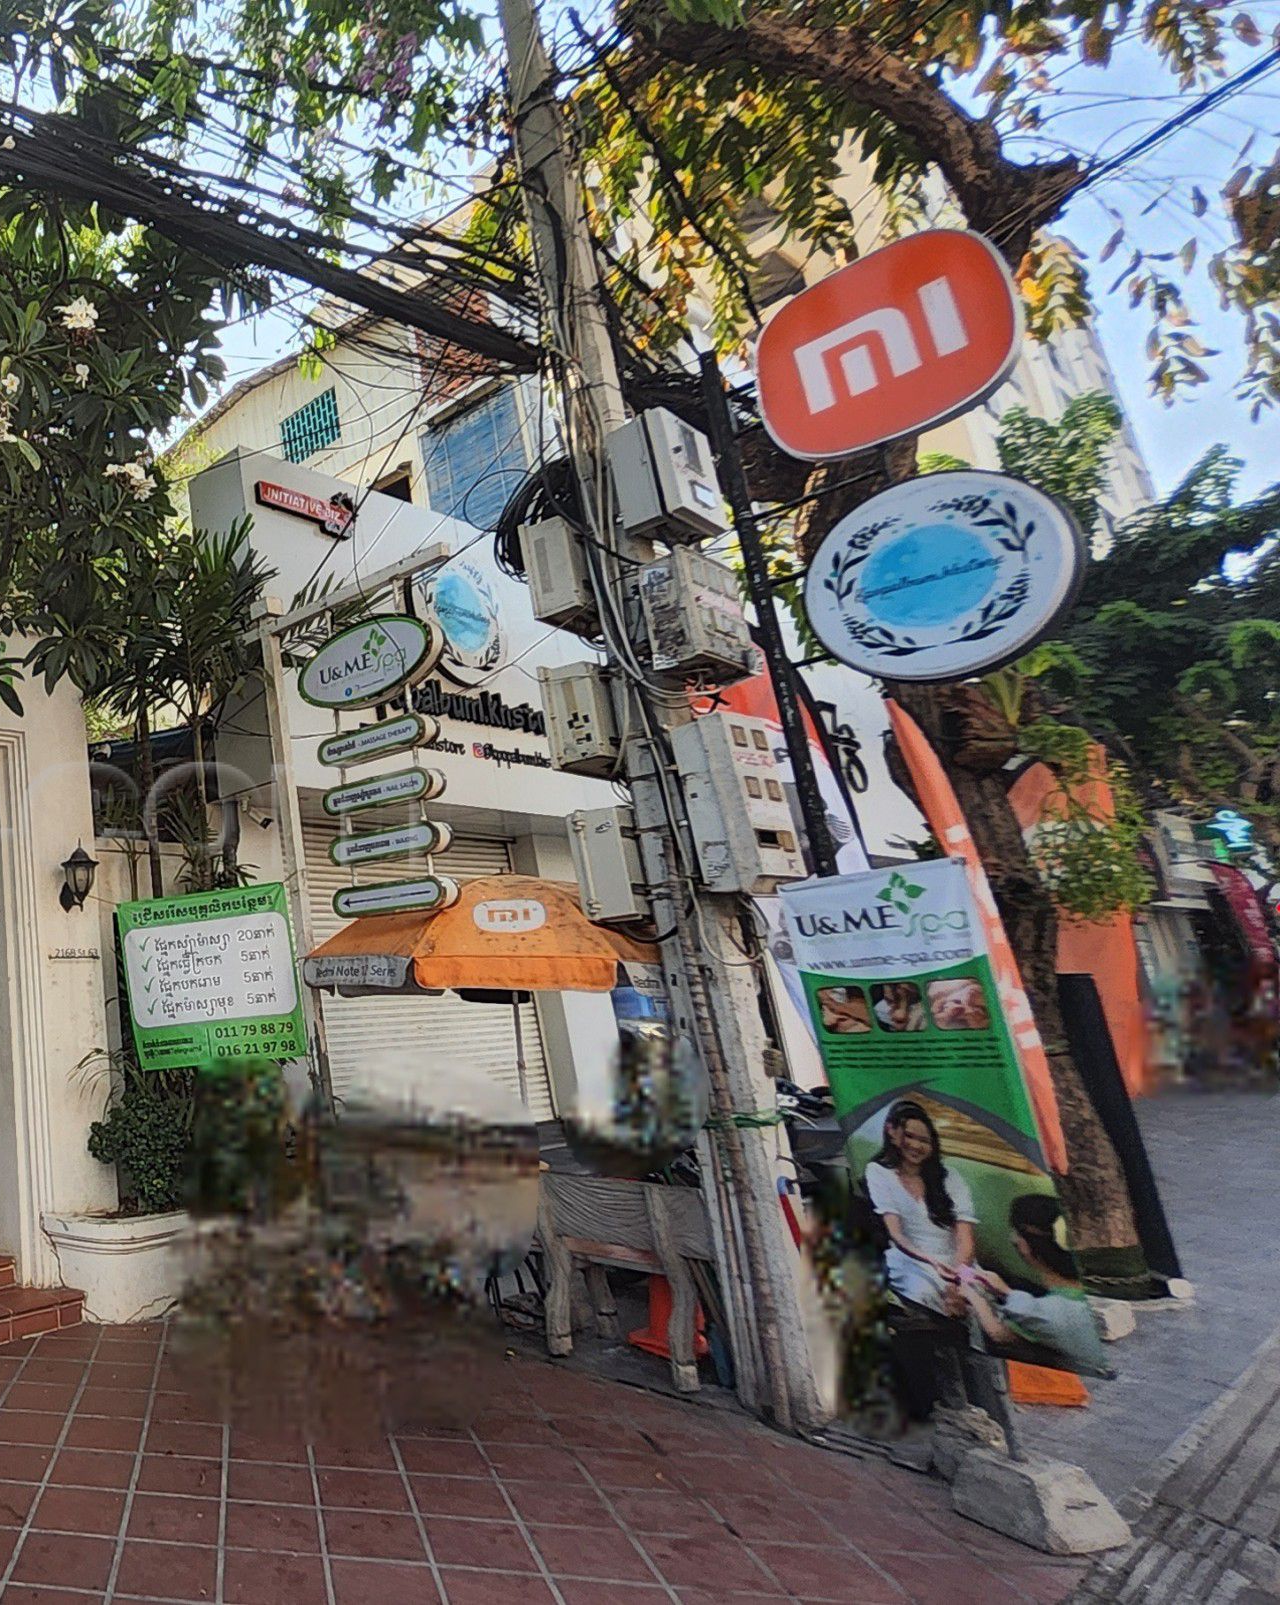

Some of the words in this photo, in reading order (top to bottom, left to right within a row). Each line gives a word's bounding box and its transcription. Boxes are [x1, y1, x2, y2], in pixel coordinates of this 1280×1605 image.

[320, 652, 373, 684] U&ME
[793, 905, 902, 938] U&ME
[336, 965, 360, 977] Note
[215, 1027, 238, 1039] 011
[241, 1025, 257, 1036] 79
[260, 1023, 276, 1034] 88
[279, 1021, 294, 1033] 79
[217, 1045, 241, 1057] 016
[244, 1043, 259, 1054] 21
[262, 1041, 277, 1053] 97
[280, 1040, 296, 1051] 98
